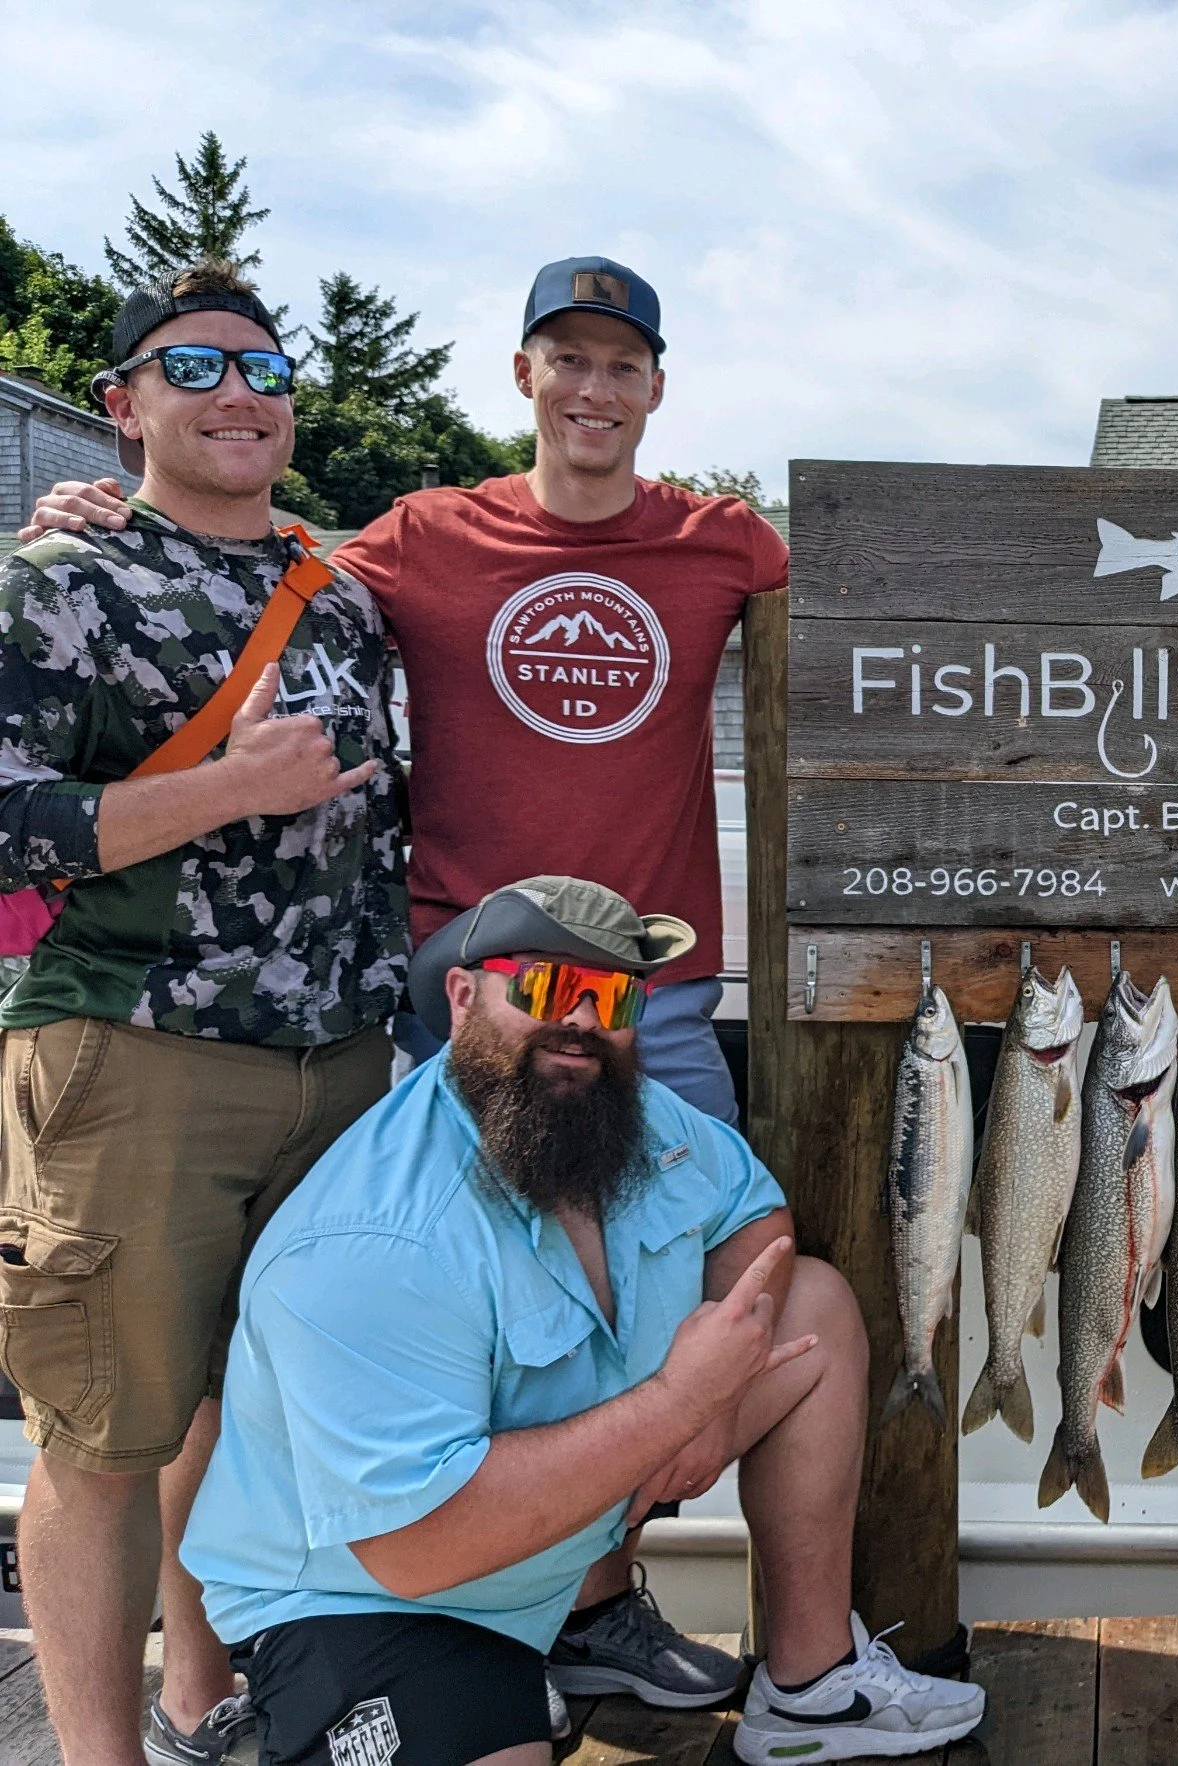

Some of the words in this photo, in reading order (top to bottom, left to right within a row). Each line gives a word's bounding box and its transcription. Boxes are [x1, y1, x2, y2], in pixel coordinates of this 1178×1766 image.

[509, 592, 575, 644] SAWTOOTH
[581, 592, 650, 653] MOUNTAINS
[518, 664, 640, 687] STANLEY
[562, 699, 597, 716] ID
[1053, 801, 1150, 836] Capt.
[842, 867, 1107, 897] 208-966-7984
